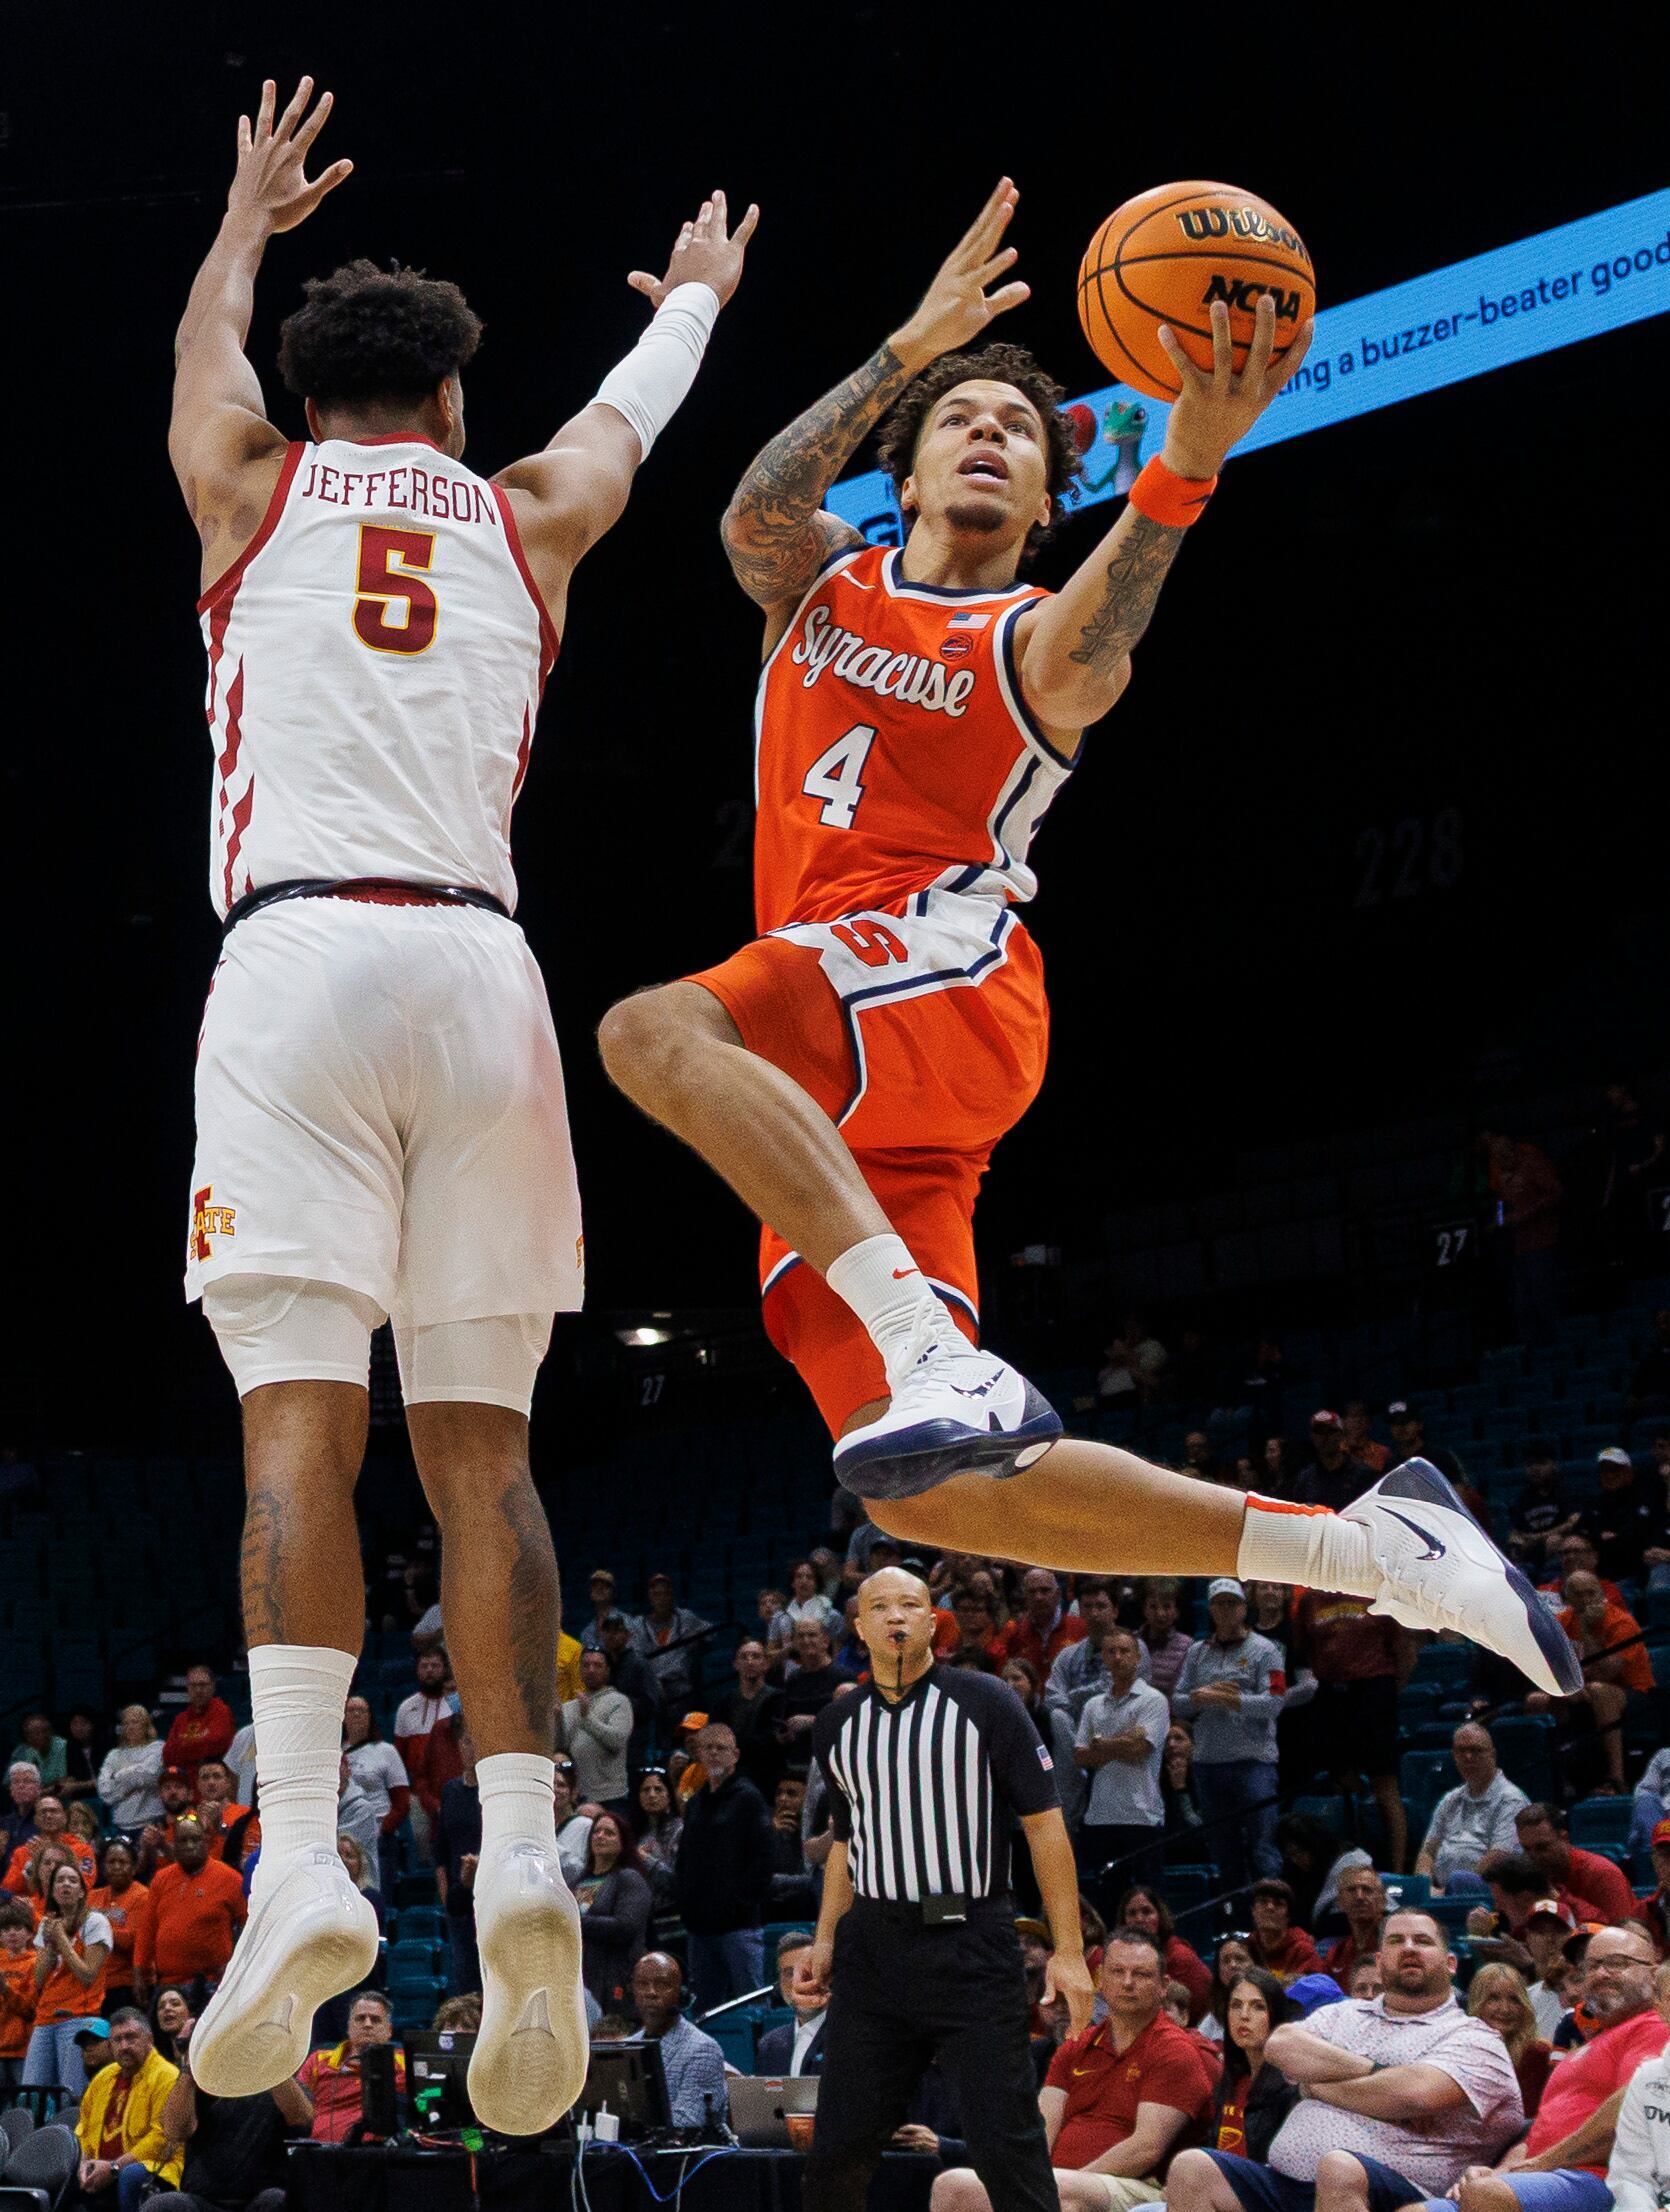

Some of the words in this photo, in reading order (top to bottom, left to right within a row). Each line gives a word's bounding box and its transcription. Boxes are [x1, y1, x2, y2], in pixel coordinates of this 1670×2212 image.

[1339, 352, 1355, 375] a
[1361, 271, 1583, 367] buzzer-beater
[302, 464, 497, 526] JEFFERSON
[351, 521, 439, 656] 5
[791, 604, 976, 717] Syracuse
[801, 722, 880, 830] 4
[1353, 808, 1464, 912] 228
[829, 919, 908, 968] S
[1437, 1229, 1467, 1266] 27
